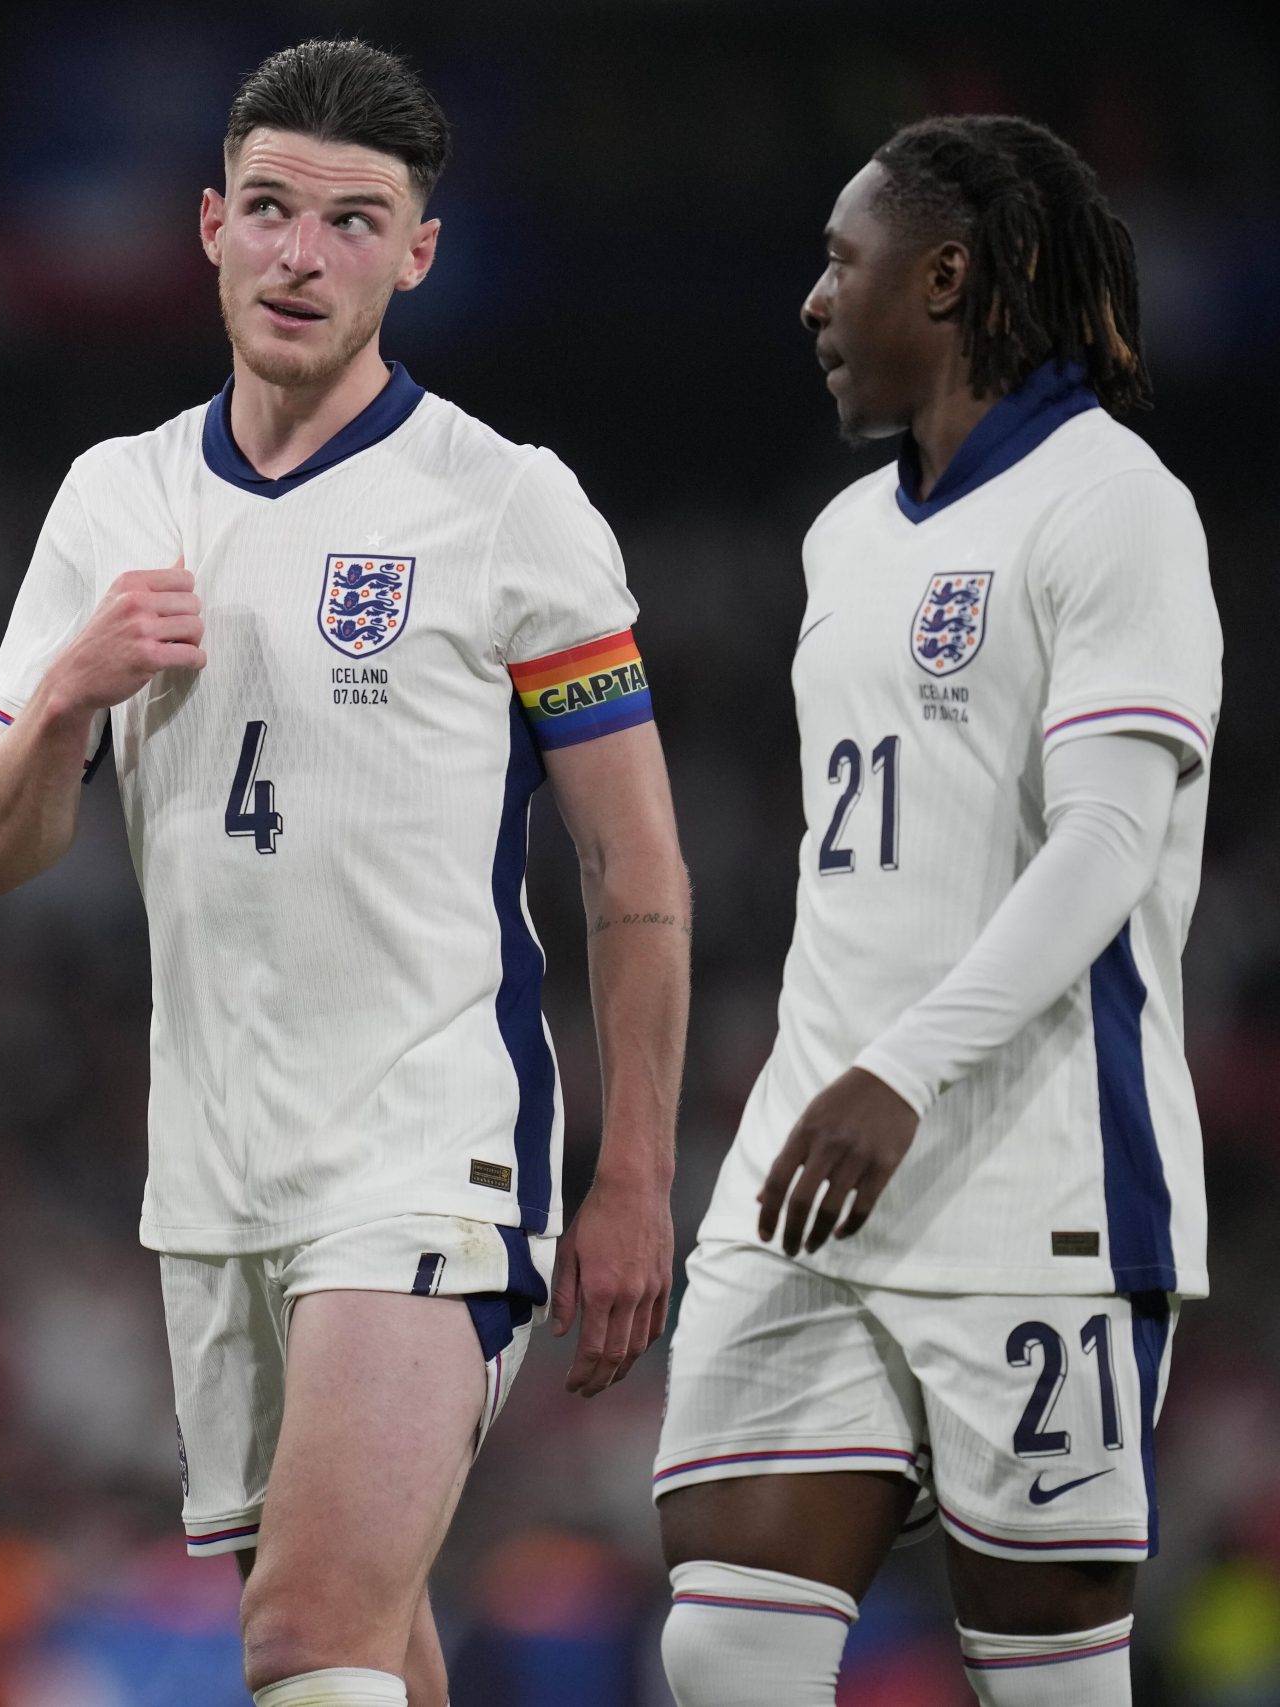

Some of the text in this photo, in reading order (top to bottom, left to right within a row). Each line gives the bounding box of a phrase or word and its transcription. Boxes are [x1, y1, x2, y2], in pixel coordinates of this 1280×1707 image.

[331, 667, 389, 684] ICELAND
[333, 688, 389, 705] 07.06.24
[538, 661, 649, 717] CAPTA
[918, 683, 970, 703] ICELAND
[225, 720, 283, 855] 4
[819, 735, 902, 876] 21
[1006, 1313, 1124, 1458] 21
